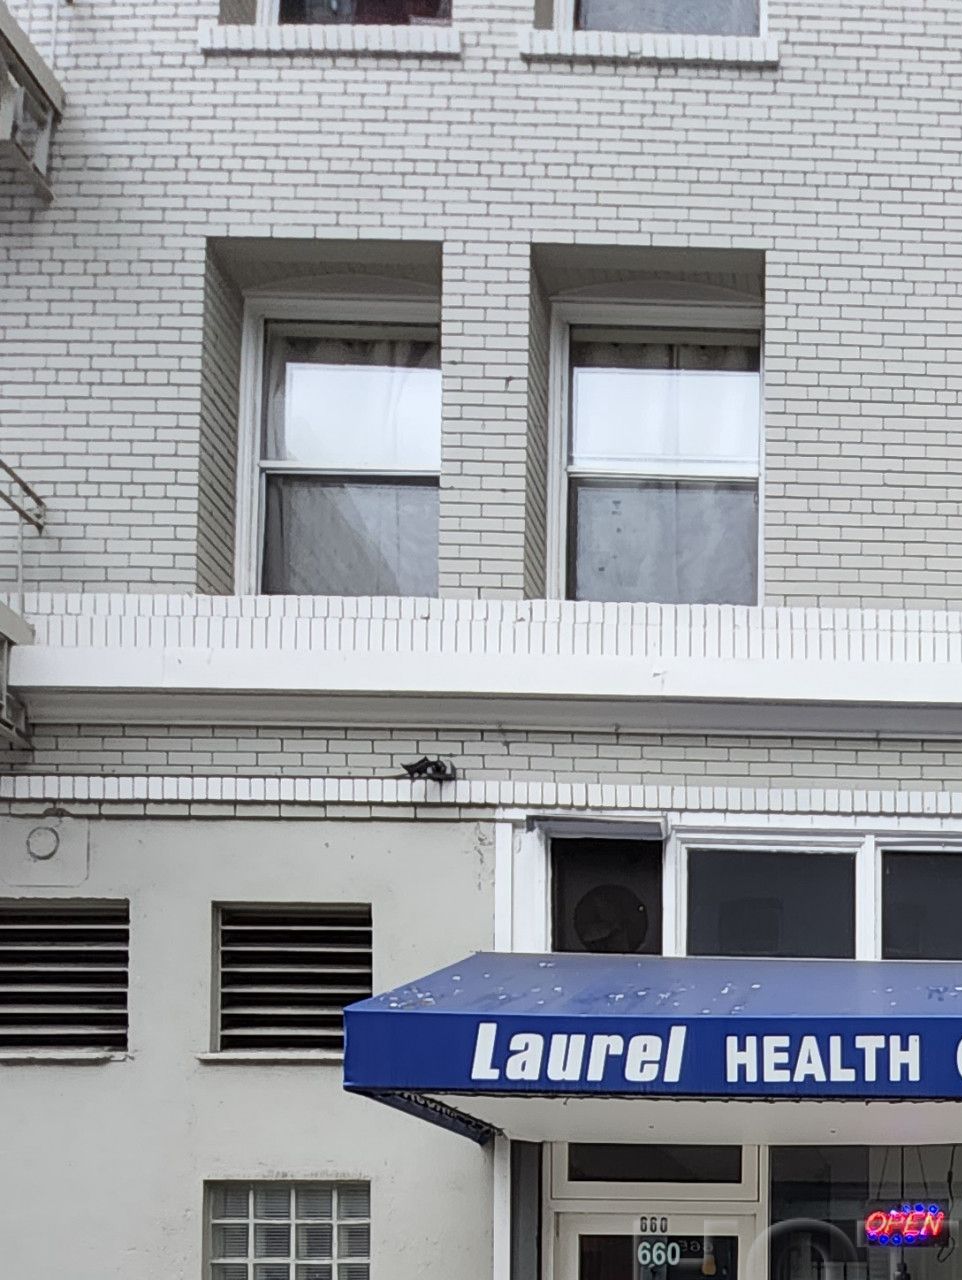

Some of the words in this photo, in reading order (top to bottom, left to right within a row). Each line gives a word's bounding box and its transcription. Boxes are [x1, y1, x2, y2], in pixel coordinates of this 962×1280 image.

[470, 1022, 687, 1083] Laurel
[725, 1034, 921, 1083] HEALTH
[640, 1216, 668, 1233] 660
[865, 1211, 944, 1236] OPEN
[638, 1242, 680, 1265] 660
